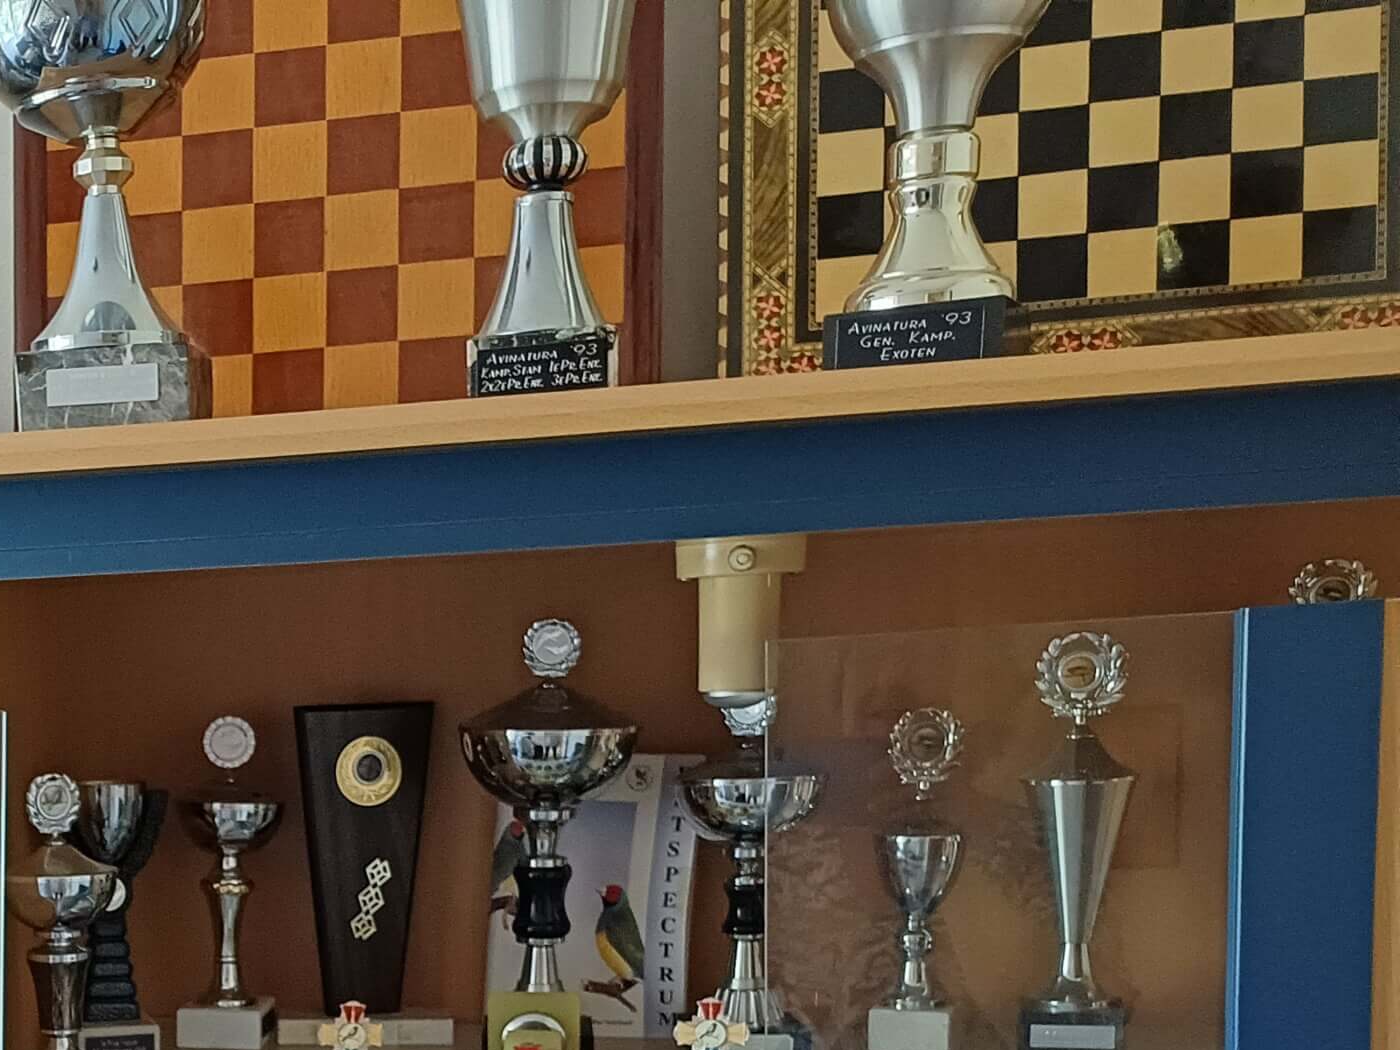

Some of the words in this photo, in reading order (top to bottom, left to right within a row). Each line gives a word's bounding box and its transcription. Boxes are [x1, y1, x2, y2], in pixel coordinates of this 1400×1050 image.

[848, 319, 927, 335] AVINATURA
[942, 311, 972, 325] '93
[860, 335, 896, 348] GEN.
[908, 331, 957, 344] KAMP.
[486, 350, 558, 365] AVINATURA
[880, 347, 937, 361] EXOTEN
